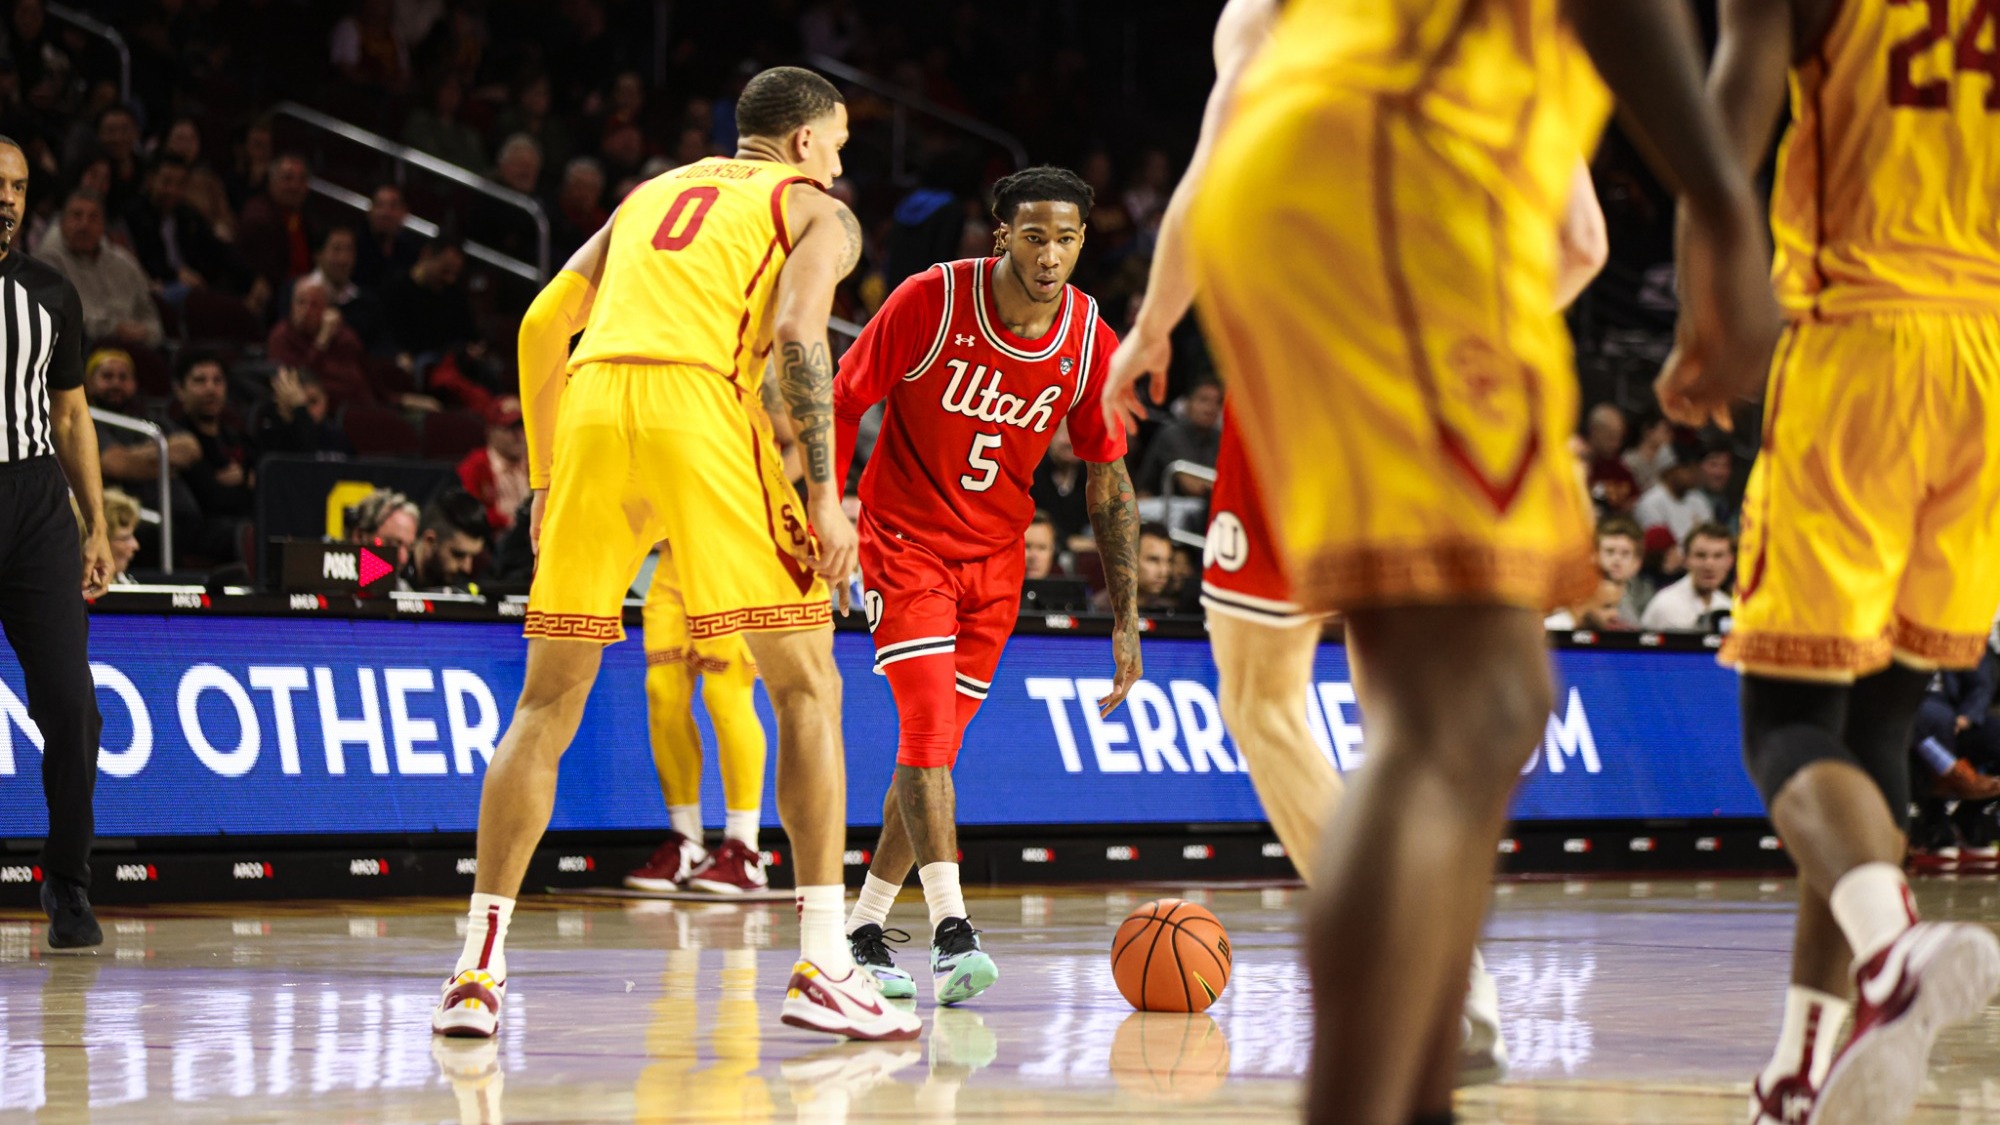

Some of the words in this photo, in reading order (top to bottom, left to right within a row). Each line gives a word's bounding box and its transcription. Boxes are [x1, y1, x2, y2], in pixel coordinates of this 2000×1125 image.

[651, 186, 720, 251] 0
[941, 358, 1062, 433] Utah
[960, 431, 1002, 492] 5
[177, 663, 500, 777] OTHER
[1, 866, 33, 883] ARCO
[116, 864, 148, 881] ARCO
